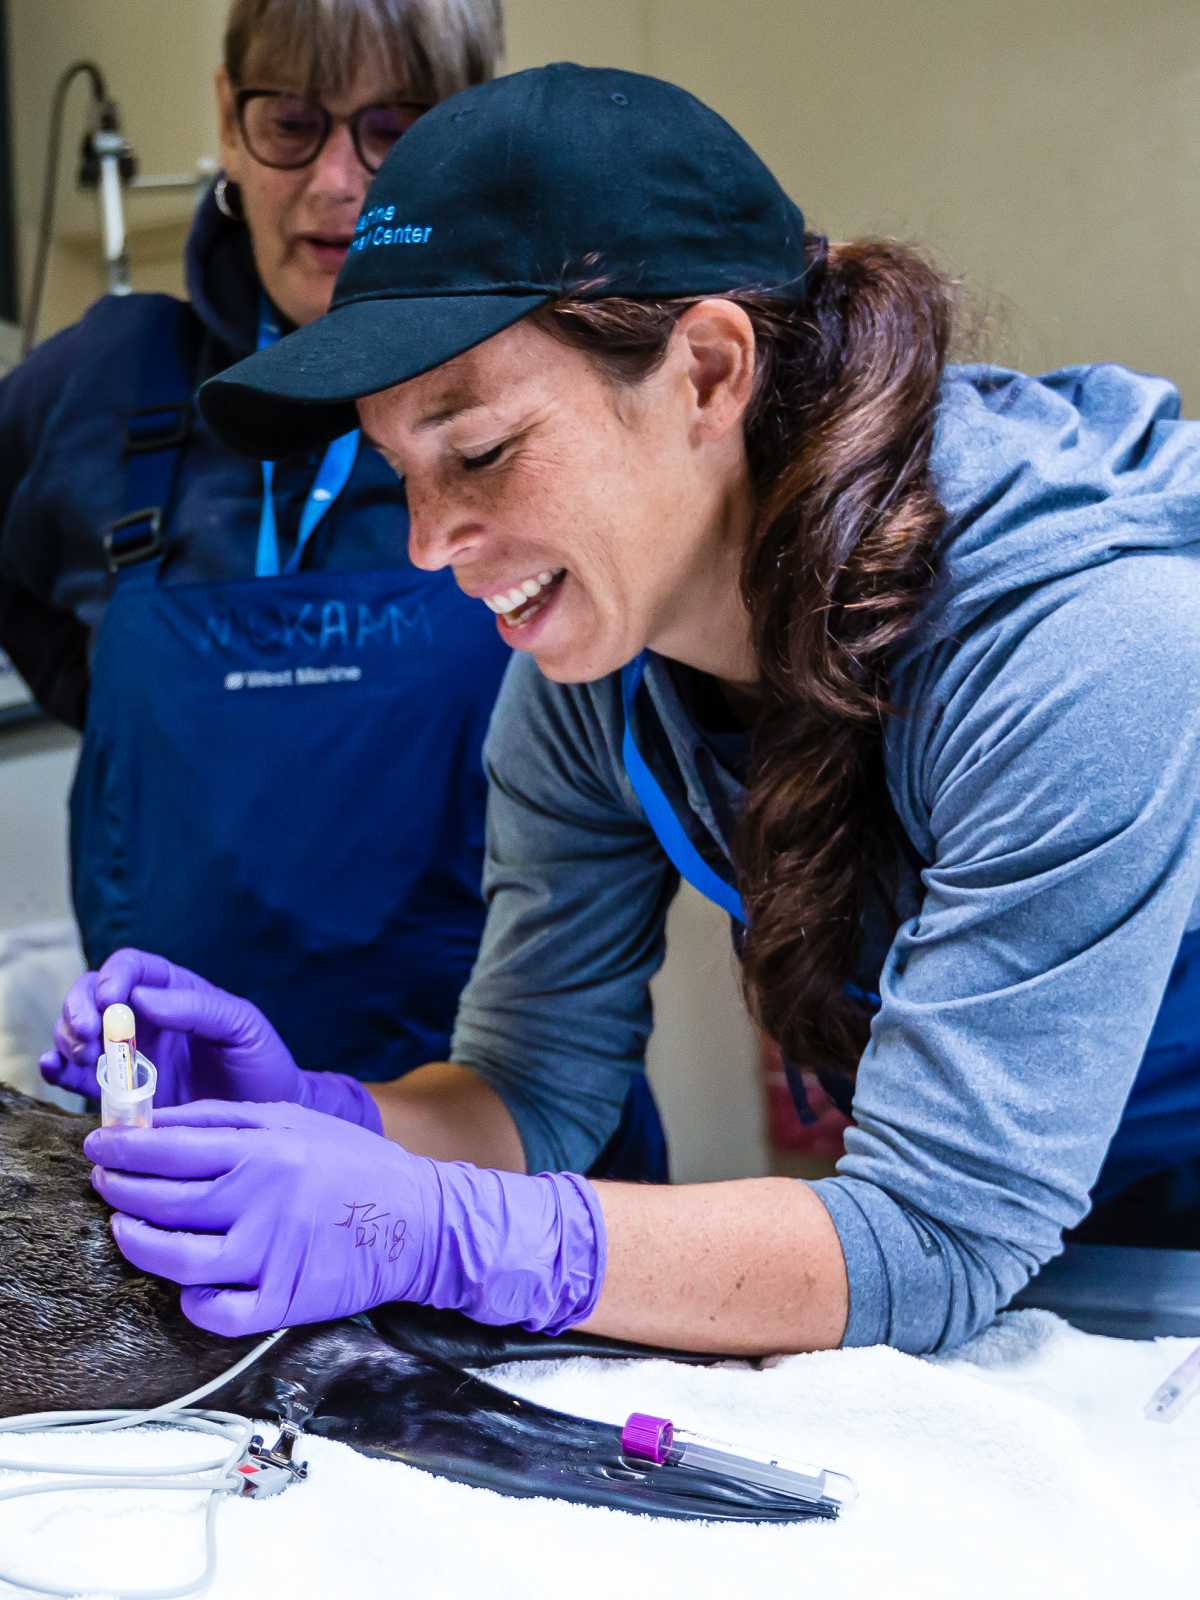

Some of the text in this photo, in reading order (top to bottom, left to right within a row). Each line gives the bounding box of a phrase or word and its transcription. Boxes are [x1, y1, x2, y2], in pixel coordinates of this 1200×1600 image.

[373, 224, 432, 246] Center
[247, 666, 361, 688] West Marine
